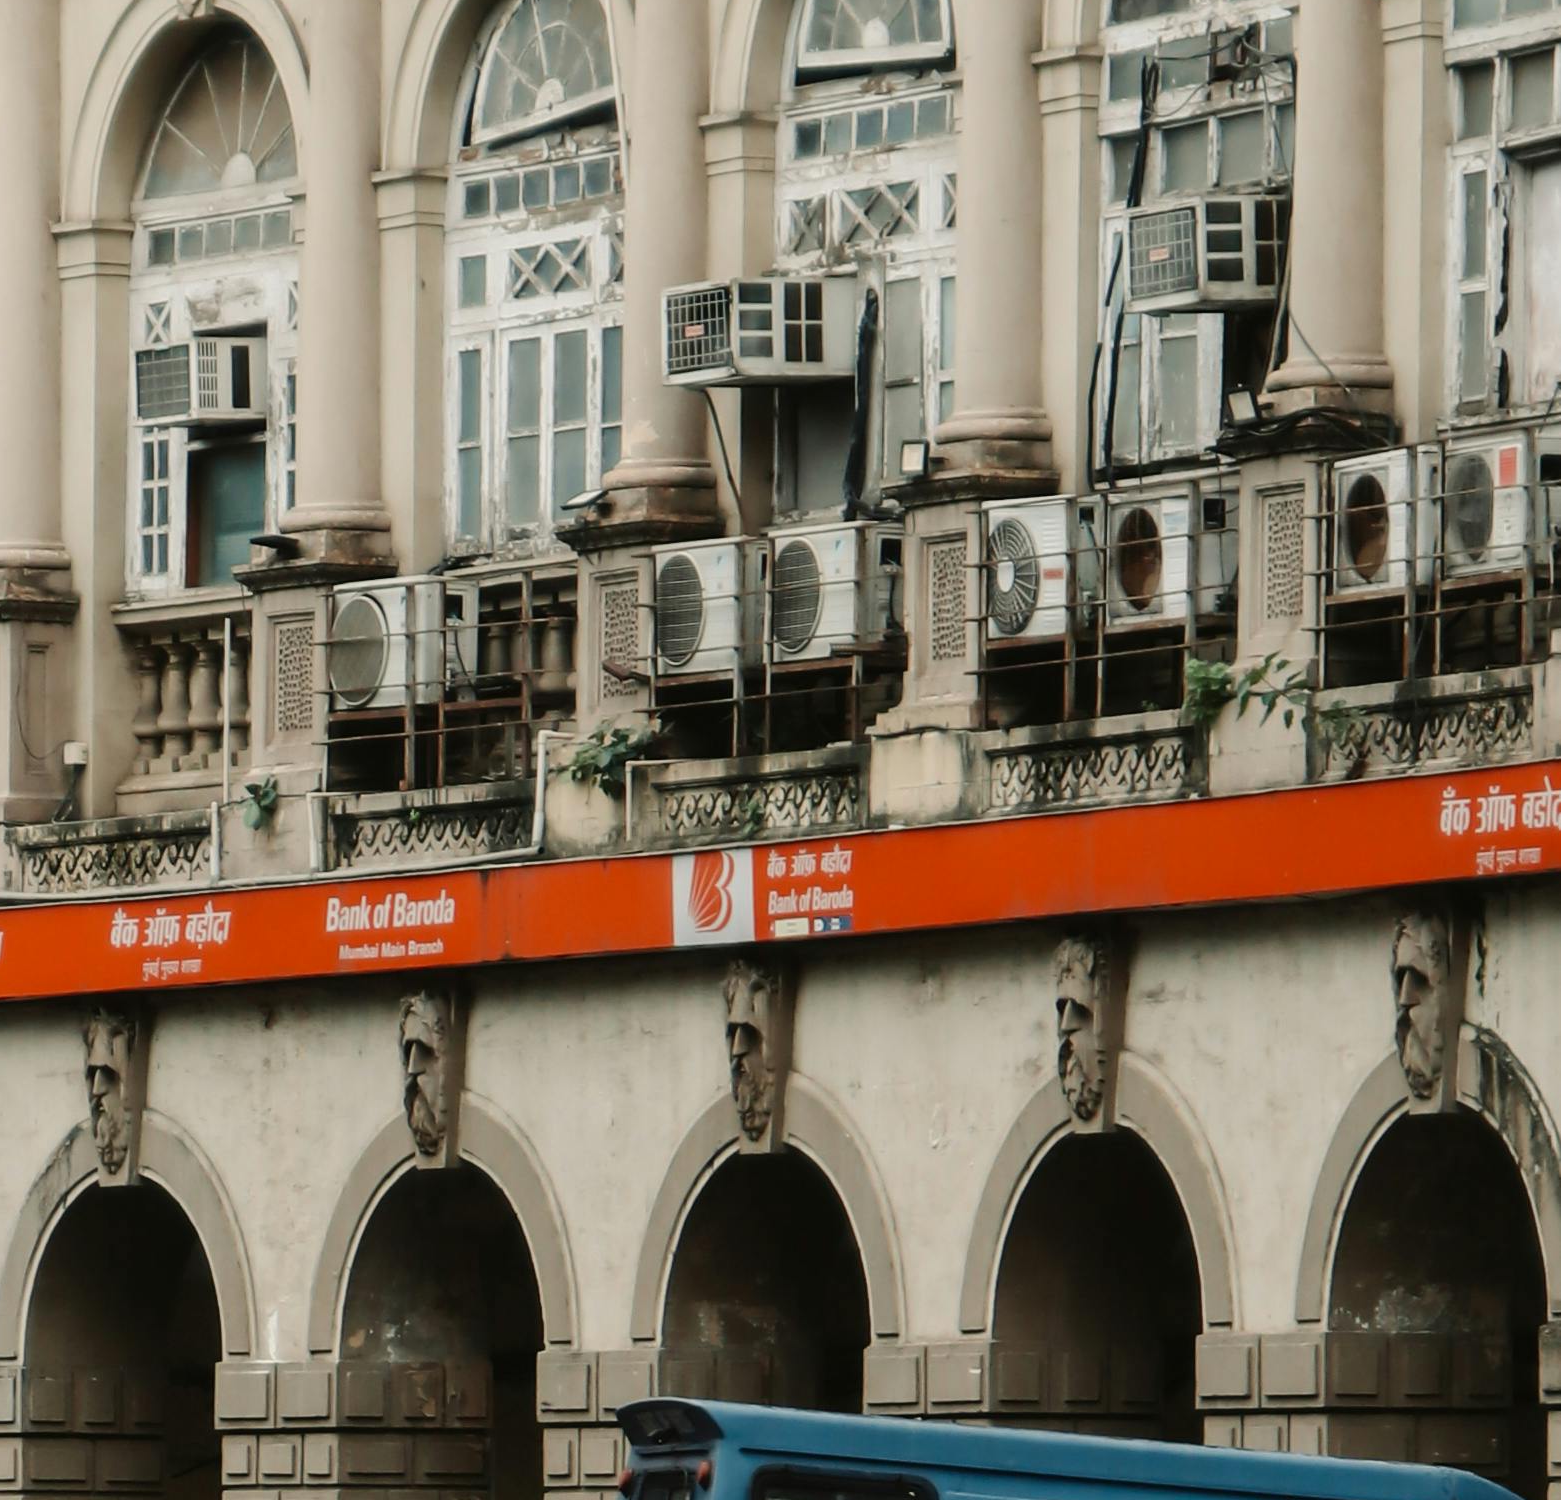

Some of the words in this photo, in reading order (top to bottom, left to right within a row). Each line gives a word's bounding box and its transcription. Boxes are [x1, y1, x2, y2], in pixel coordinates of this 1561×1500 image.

[326, 895, 371, 932] Bank
[373, 893, 392, 929] of
[393, 889, 455, 928] Baroda
[768, 890, 798, 915] Bank
[799, 887, 812, 912] of
[812, 884, 853, 911] Baroda
[339, 943, 379, 960] Mumbai
[381, 942, 406, 957] Main
[408, 938, 444, 956] Branch
